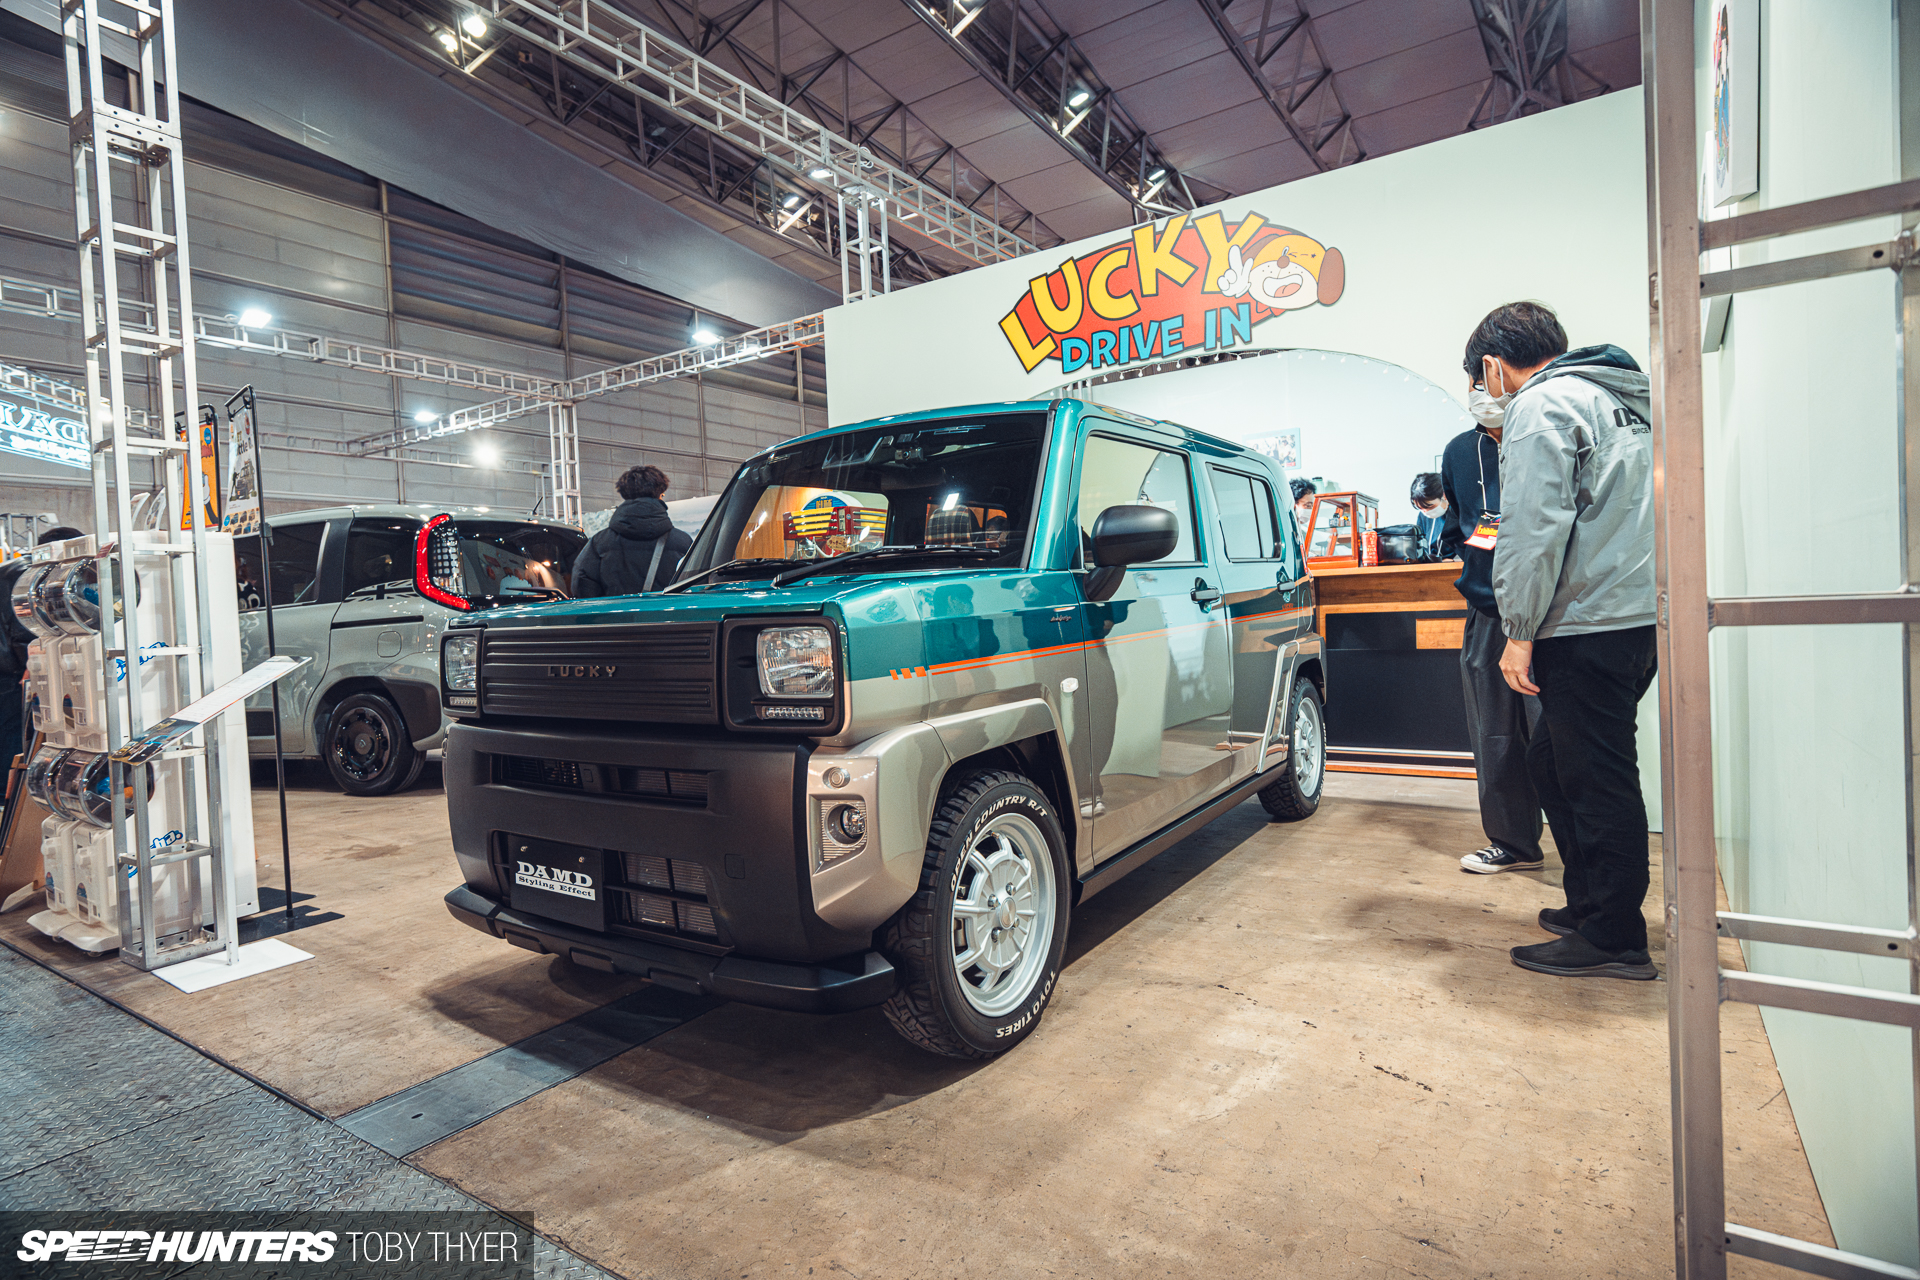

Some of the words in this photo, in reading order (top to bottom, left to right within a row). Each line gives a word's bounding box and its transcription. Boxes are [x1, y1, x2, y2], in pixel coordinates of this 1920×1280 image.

[998, 209, 1270, 374] LUCKY
[1061, 313, 1184, 374] DRIVE
[1204, 302, 1252, 351] IN
[547, 665, 616, 678] LUCKY
[950, 830, 973, 892] OPEN
[974, 795, 1026, 832] COUNTRY
[1027, 798, 1048, 817] R/T
[516, 860, 593, 888] DAMD
[518, 875, 555, 891] Styling
[559, 884, 592, 897] Effect
[1032, 970, 1056, 1015] TOYO
[995, 1011, 1033, 1039] TIRES
